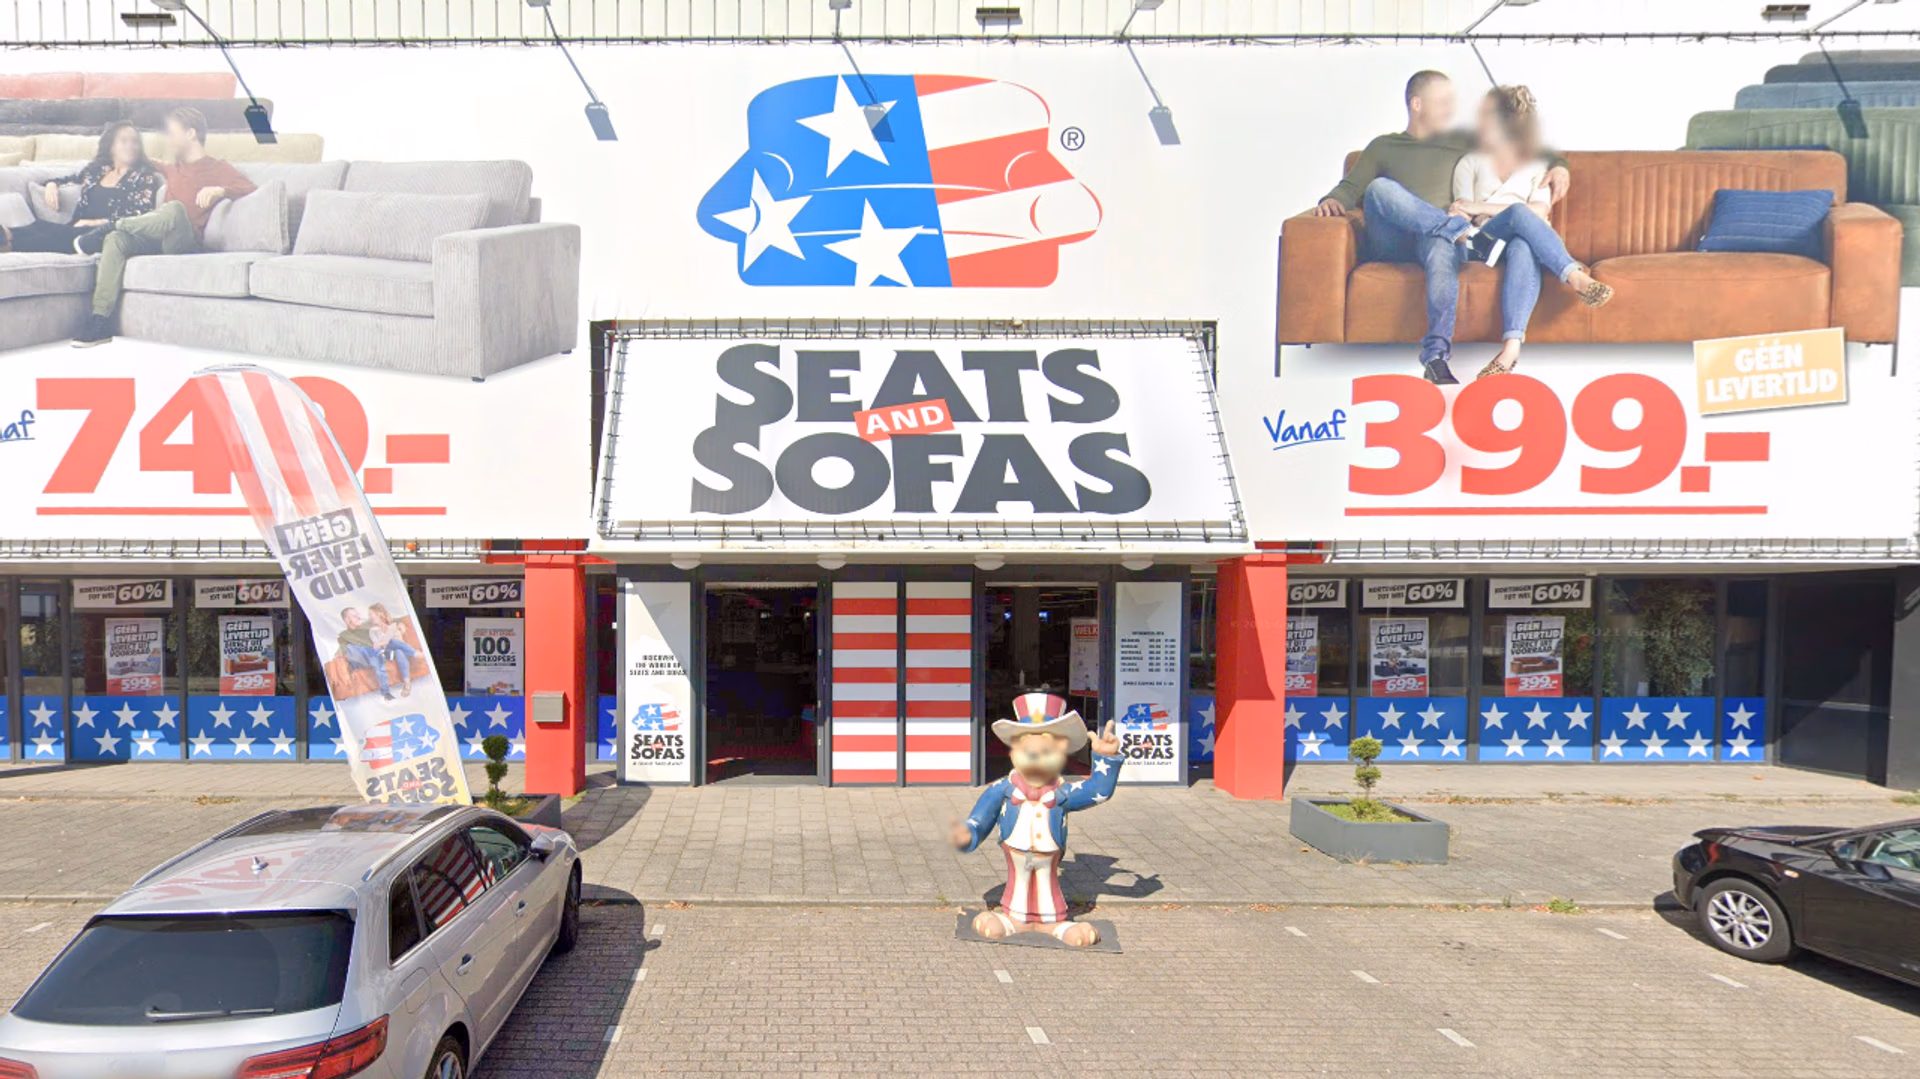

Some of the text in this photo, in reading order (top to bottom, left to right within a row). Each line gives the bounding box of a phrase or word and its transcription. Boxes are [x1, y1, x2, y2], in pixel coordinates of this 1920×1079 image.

[715, 344, 1120, 425] SEATS
[1705, 368, 1837, 403] LEVERTIJD
[865, 405, 945, 434] AND
[1263, 409, 1347, 443] Vanaf
[690, 426, 1152, 515] SOFAS
[118, 583, 163, 601] 60%
[237, 583, 280, 601] 60%
[472, 583, 518, 601] 60%
[1290, 583, 1336, 601] 60%
[1408, 583, 1453, 601] 60%
[1534, 583, 1580, 601] 60%
[1074, 625, 1098, 637] WELK
[1287, 630, 1313, 639] RTIJD
[1376, 632, 1422, 644] LEVERTIJD
[1512, 629, 1560, 641] LEVERTIJD
[473, 636, 511, 655] 100
[633, 733, 684, 747] SEATS
[1122, 733, 1173, 747] SEATS
[631, 746, 685, 760] SOFAS
[1120, 746, 1174, 760] SOFAS
